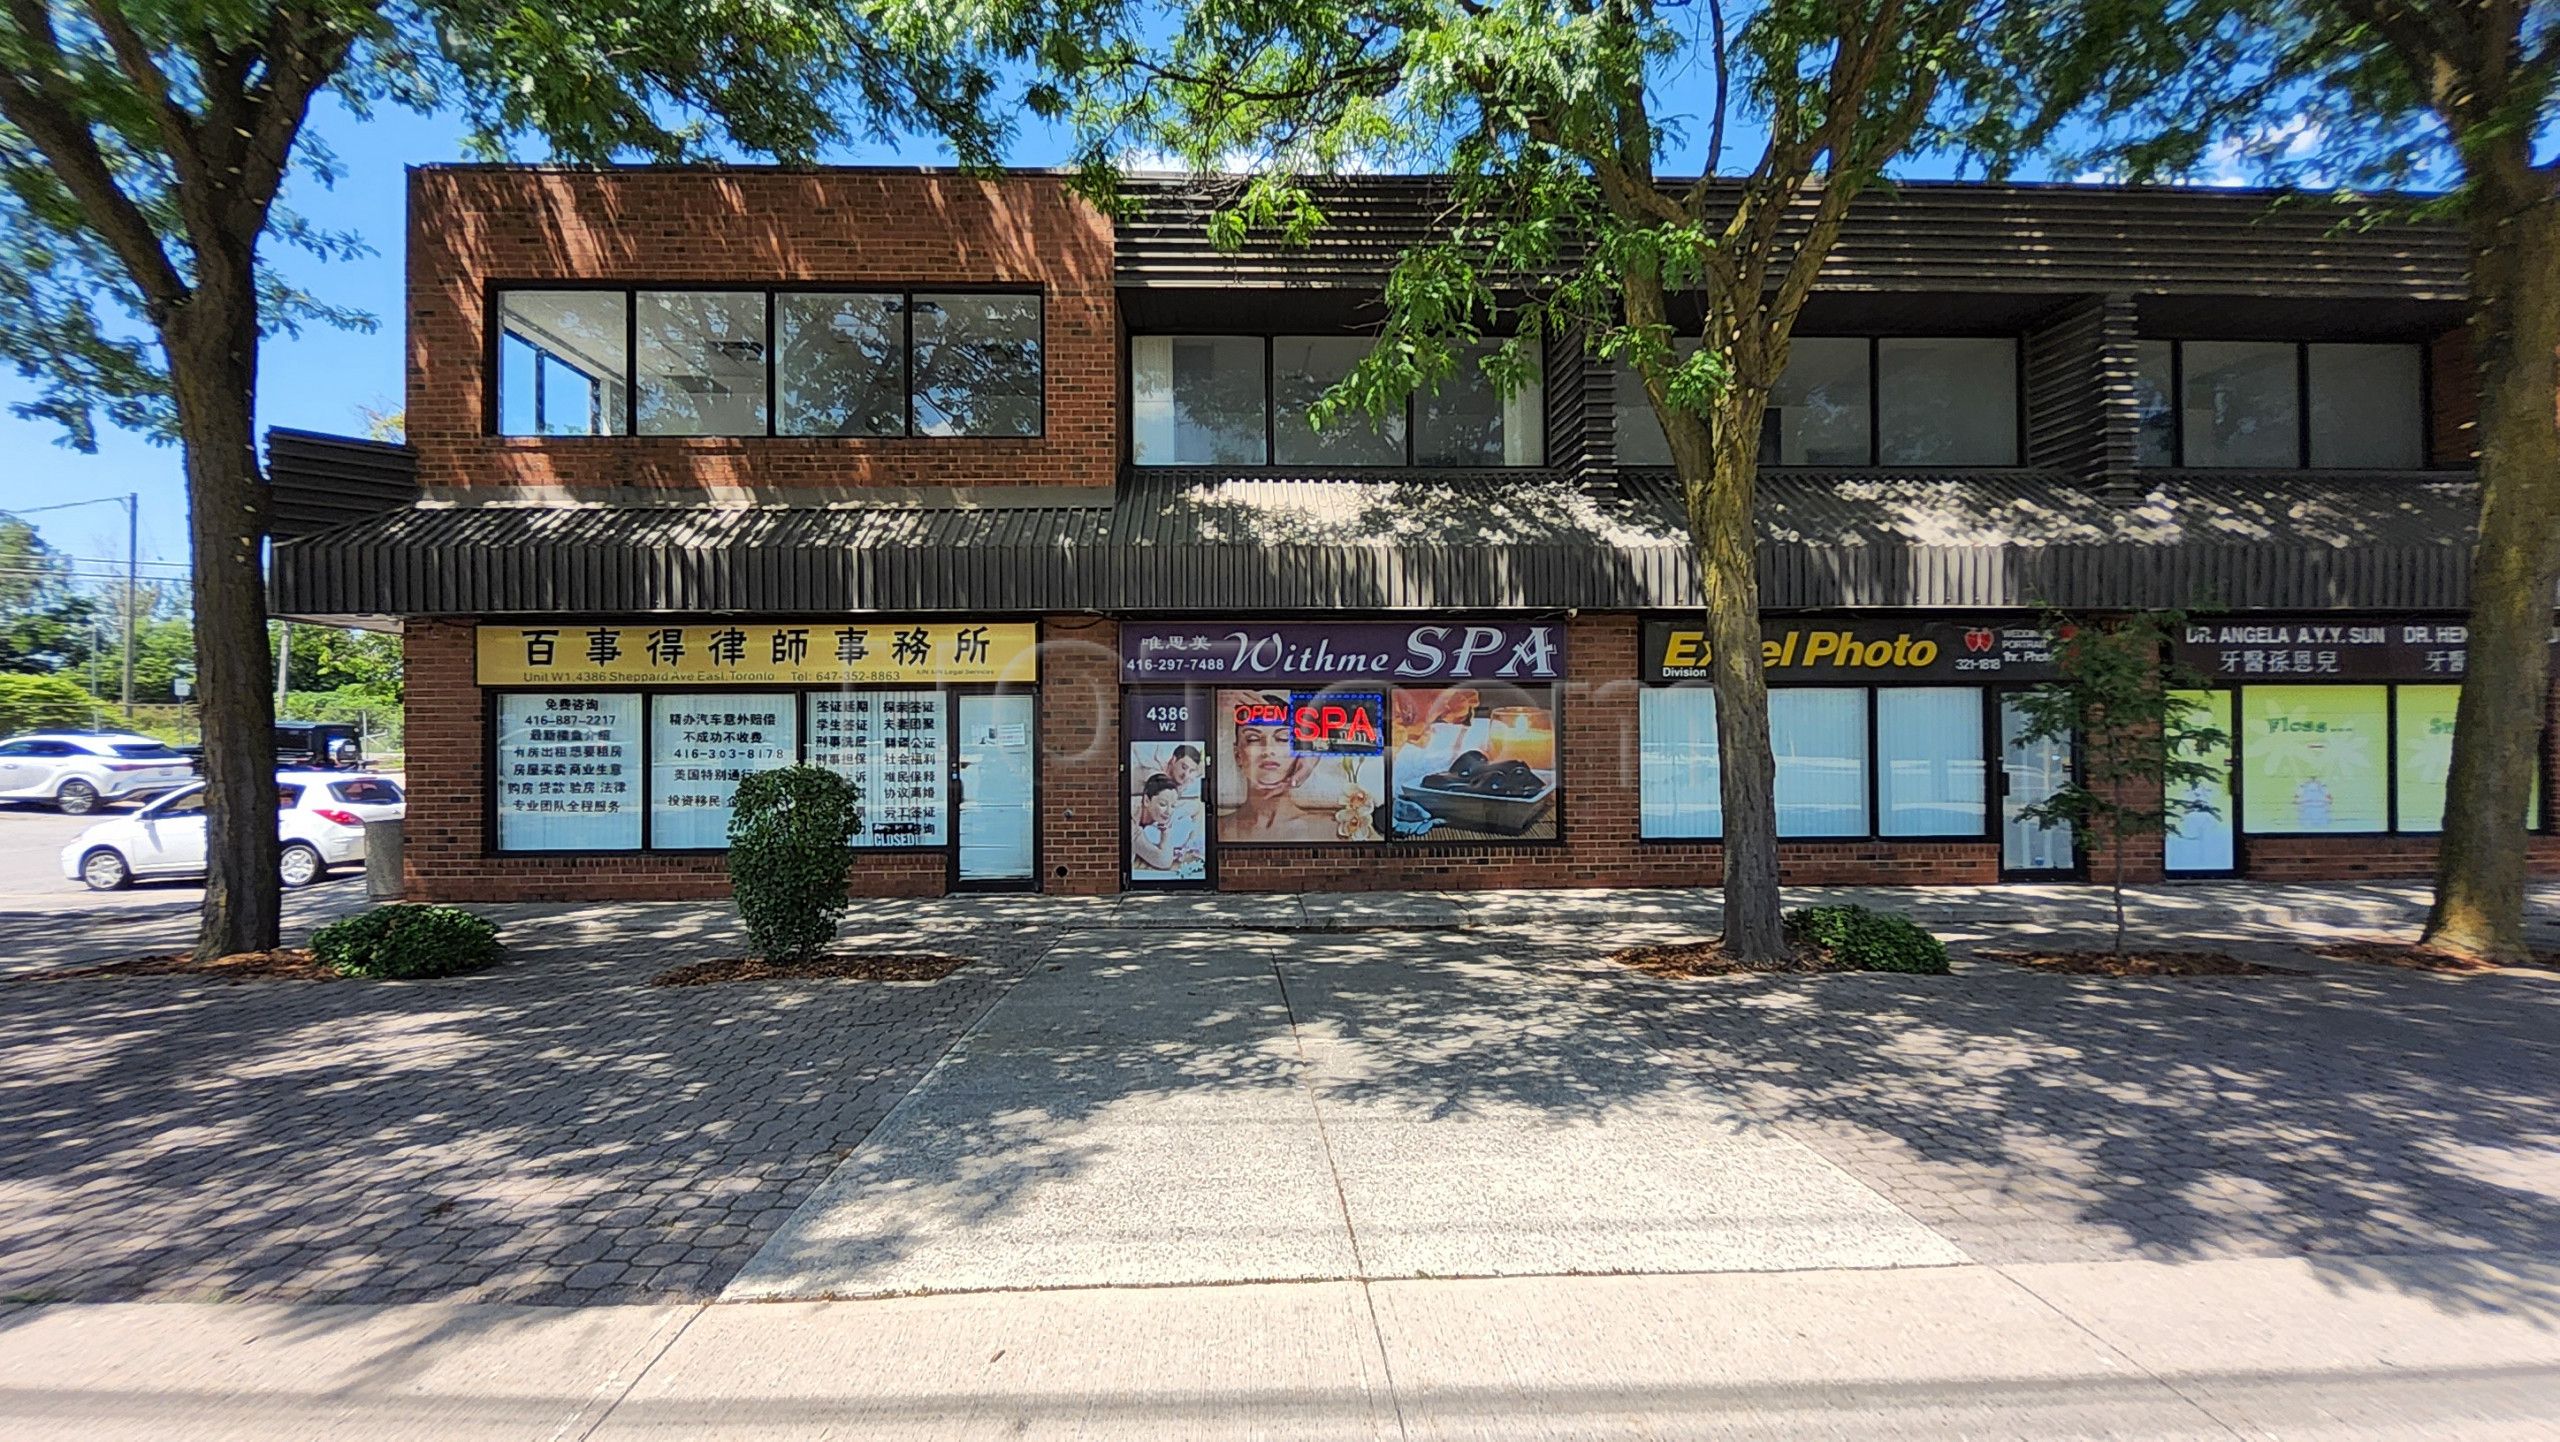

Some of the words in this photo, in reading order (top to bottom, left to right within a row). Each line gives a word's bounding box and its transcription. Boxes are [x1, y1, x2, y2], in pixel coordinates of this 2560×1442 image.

[2219, 627, 2290, 644] ANGELA
[2349, 627, 2386, 644] SUN
[521, 626, 991, 667] 百事得律師事務所
[1223, 631, 1390, 673] Withme
[1394, 626, 1559, 678] SPA
[1662, 631, 1801, 669] Exel
[1802, 631, 1938, 667] Photo
[1126, 658, 1225, 672] 416-297-7488
[1955, 658, 2001, 671] 321-1818
[609, 671, 669, 683] Sheppard
[672, 672, 694, 682] Ave
[731, 670, 775, 681] Toronto
[790, 670, 812, 681] Tel:
[815, 670, 900, 681] 647-352-8863
[1662, 667, 1707, 678] Division
[545, 698, 599, 711] 免费咨询
[1147, 706, 1189, 721] 4386
[1233, 705, 1288, 725] OPEN
[525, 715, 616, 726] 416-887-2217
[1158, 722, 1177, 732] W2
[1294, 706, 1377, 742] SPA
[673, 748, 784, 759] 416-303-8178
[674, 768, 764, 782] 美国特别通行
[874, 833, 915, 846] CLOSED
